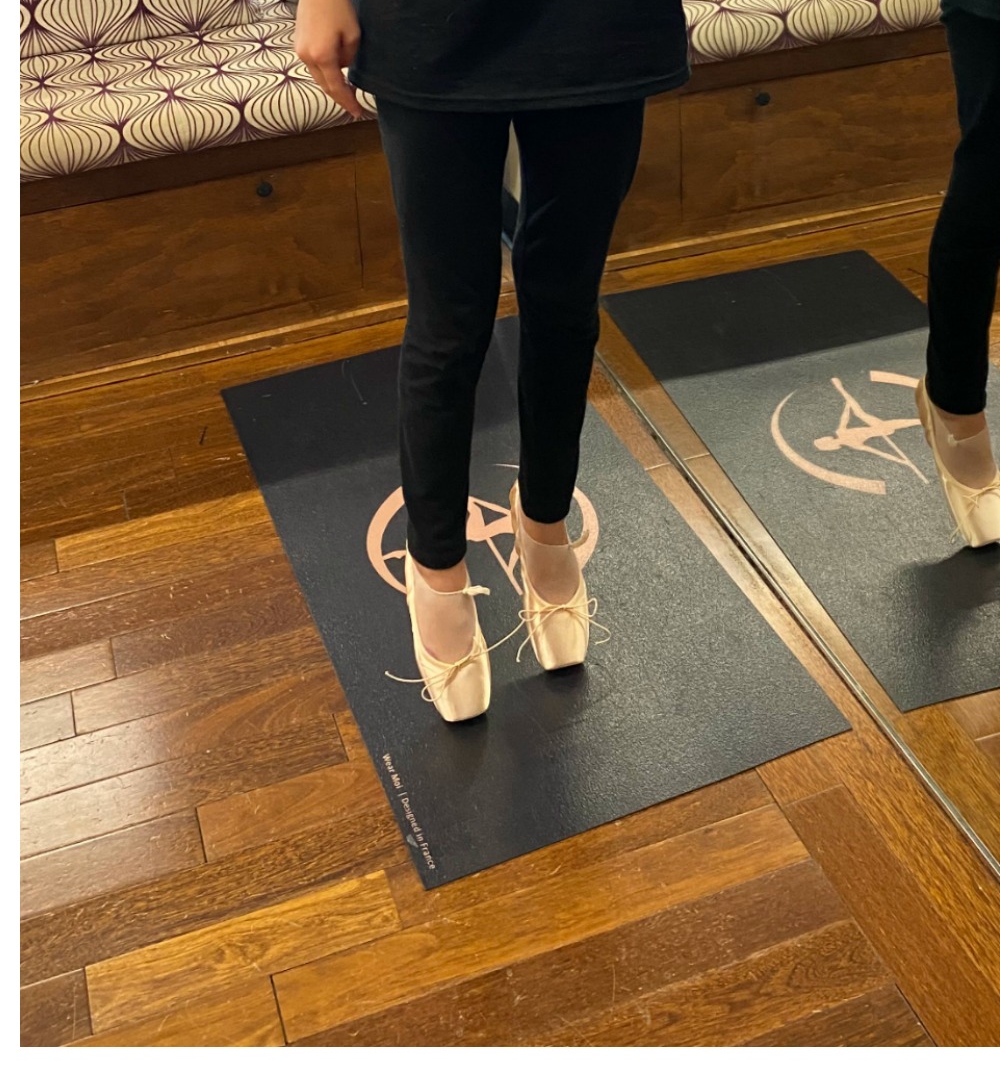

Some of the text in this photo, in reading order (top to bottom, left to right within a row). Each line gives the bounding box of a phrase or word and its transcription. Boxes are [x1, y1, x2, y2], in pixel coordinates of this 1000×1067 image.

[382, 752, 436, 870] Wear Moi Designed in France
